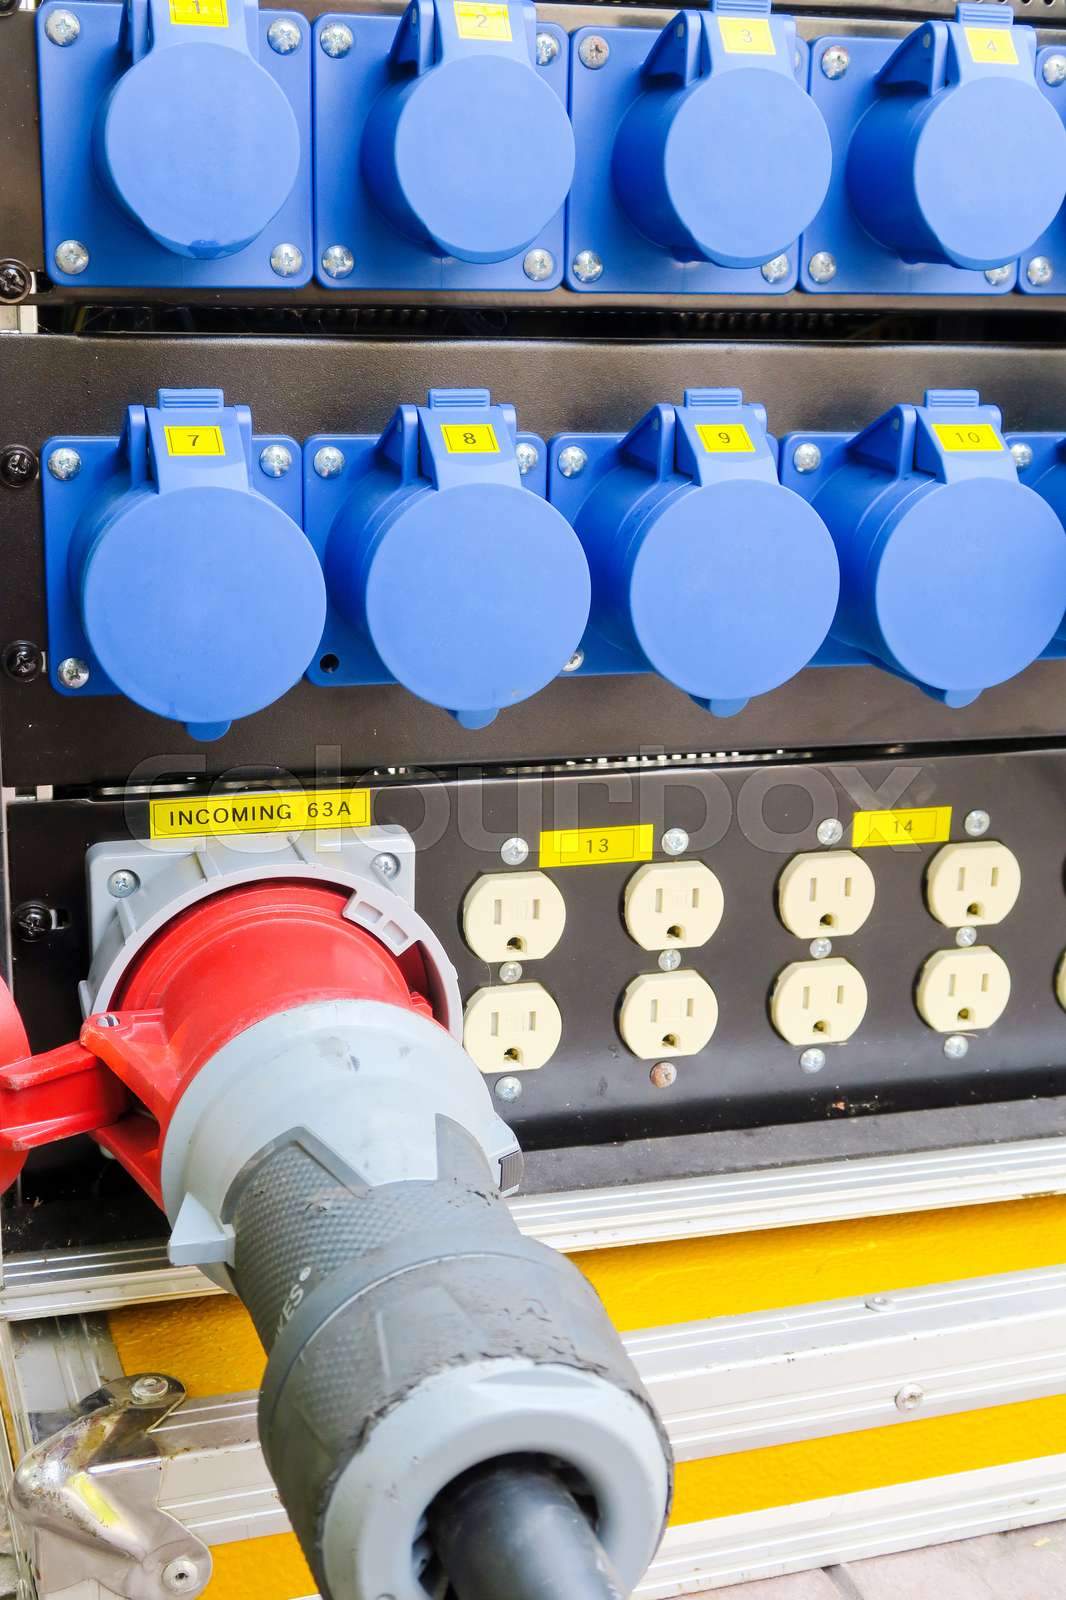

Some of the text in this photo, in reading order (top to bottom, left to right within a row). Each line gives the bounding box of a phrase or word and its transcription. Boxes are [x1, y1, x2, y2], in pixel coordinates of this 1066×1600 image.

[475, 14, 488, 29] 2
[741, 29, 754, 44] 3
[986, 38, 998, 53] 4
[187, 434, 200, 447] 7
[463, 432, 477, 445] 8
[717, 431, 731, 444] 9
[955, 431, 981, 445] 10
[169, 801, 352, 827] INCOMING 63A
[894, 819, 914, 834] 14
[586, 838, 609, 854] 13
